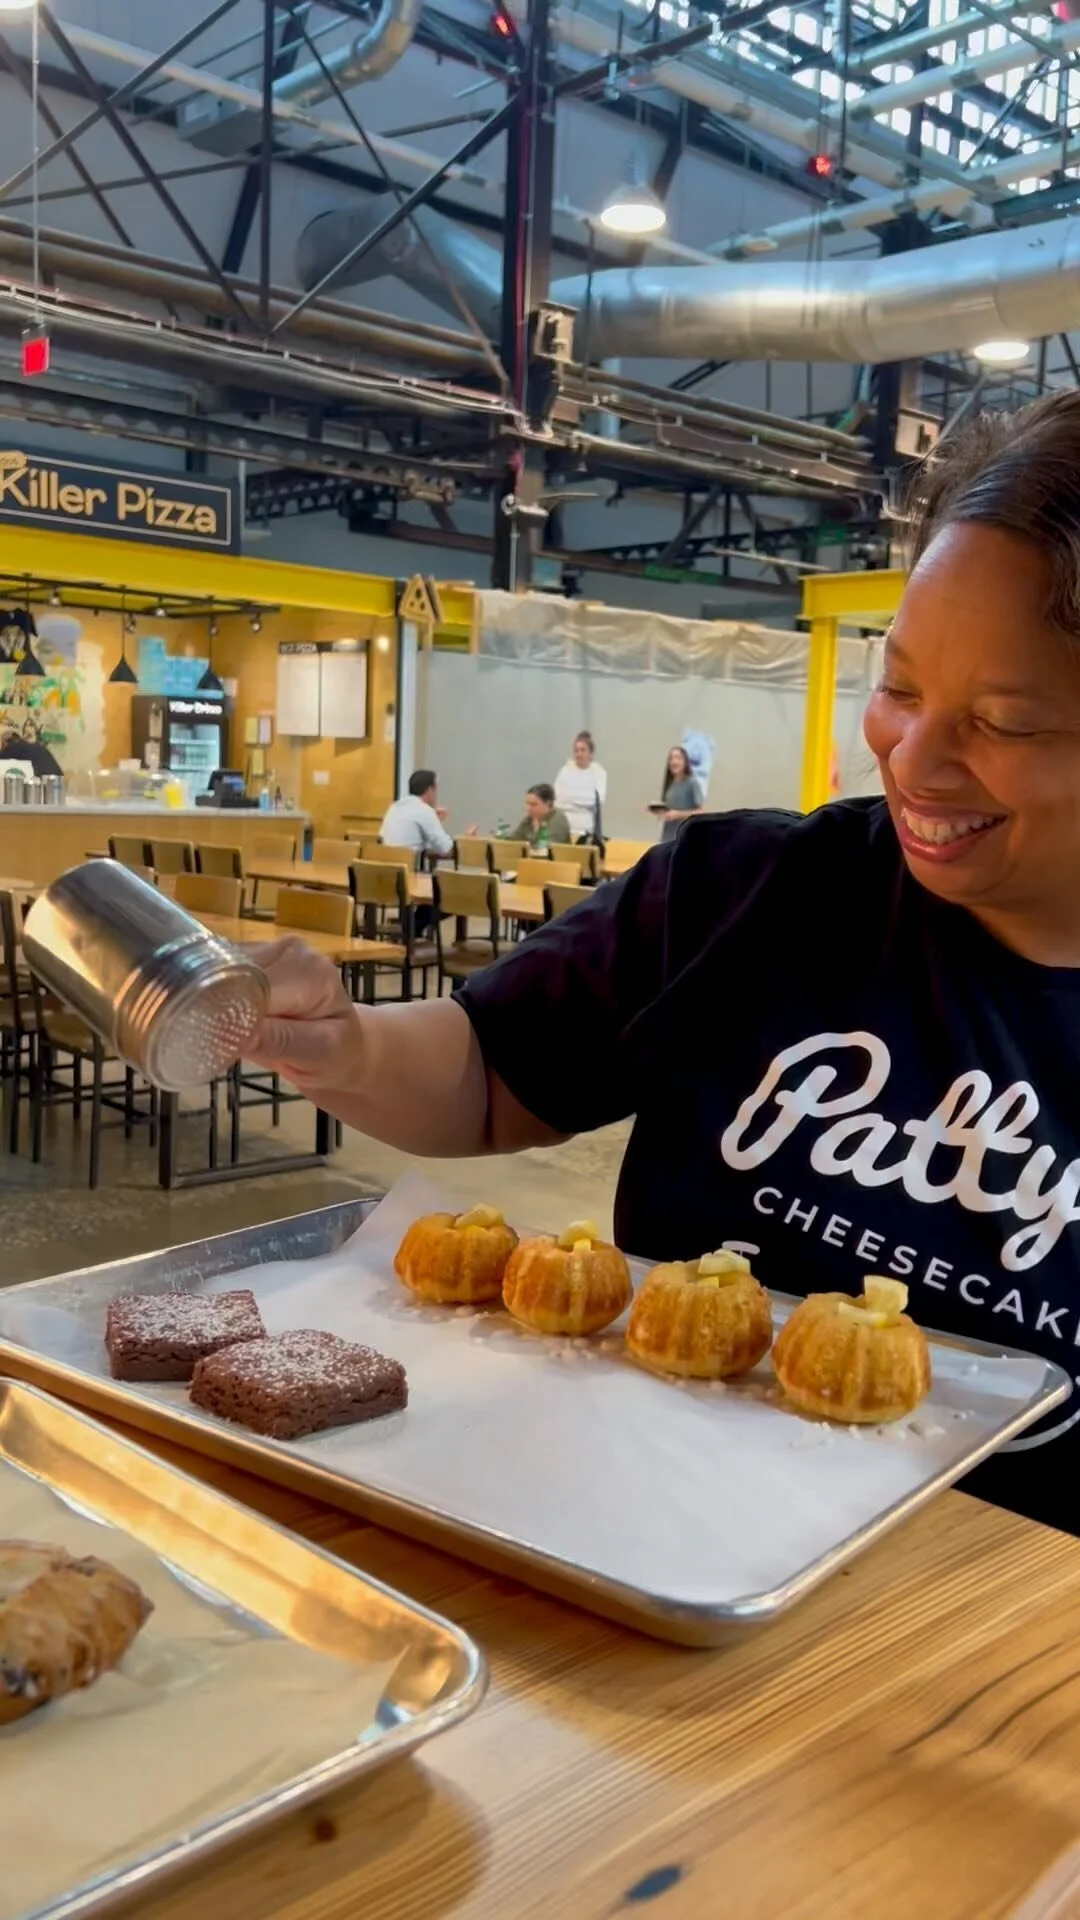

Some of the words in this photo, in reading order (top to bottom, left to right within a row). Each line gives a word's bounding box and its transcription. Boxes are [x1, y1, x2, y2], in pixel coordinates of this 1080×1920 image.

[0, 467, 108, 516] Killer
[117, 482, 217, 534] Pizza
[721, 1031, 1080, 1271] Patty
[753, 1186, 1080, 1346] CHEESECAK
